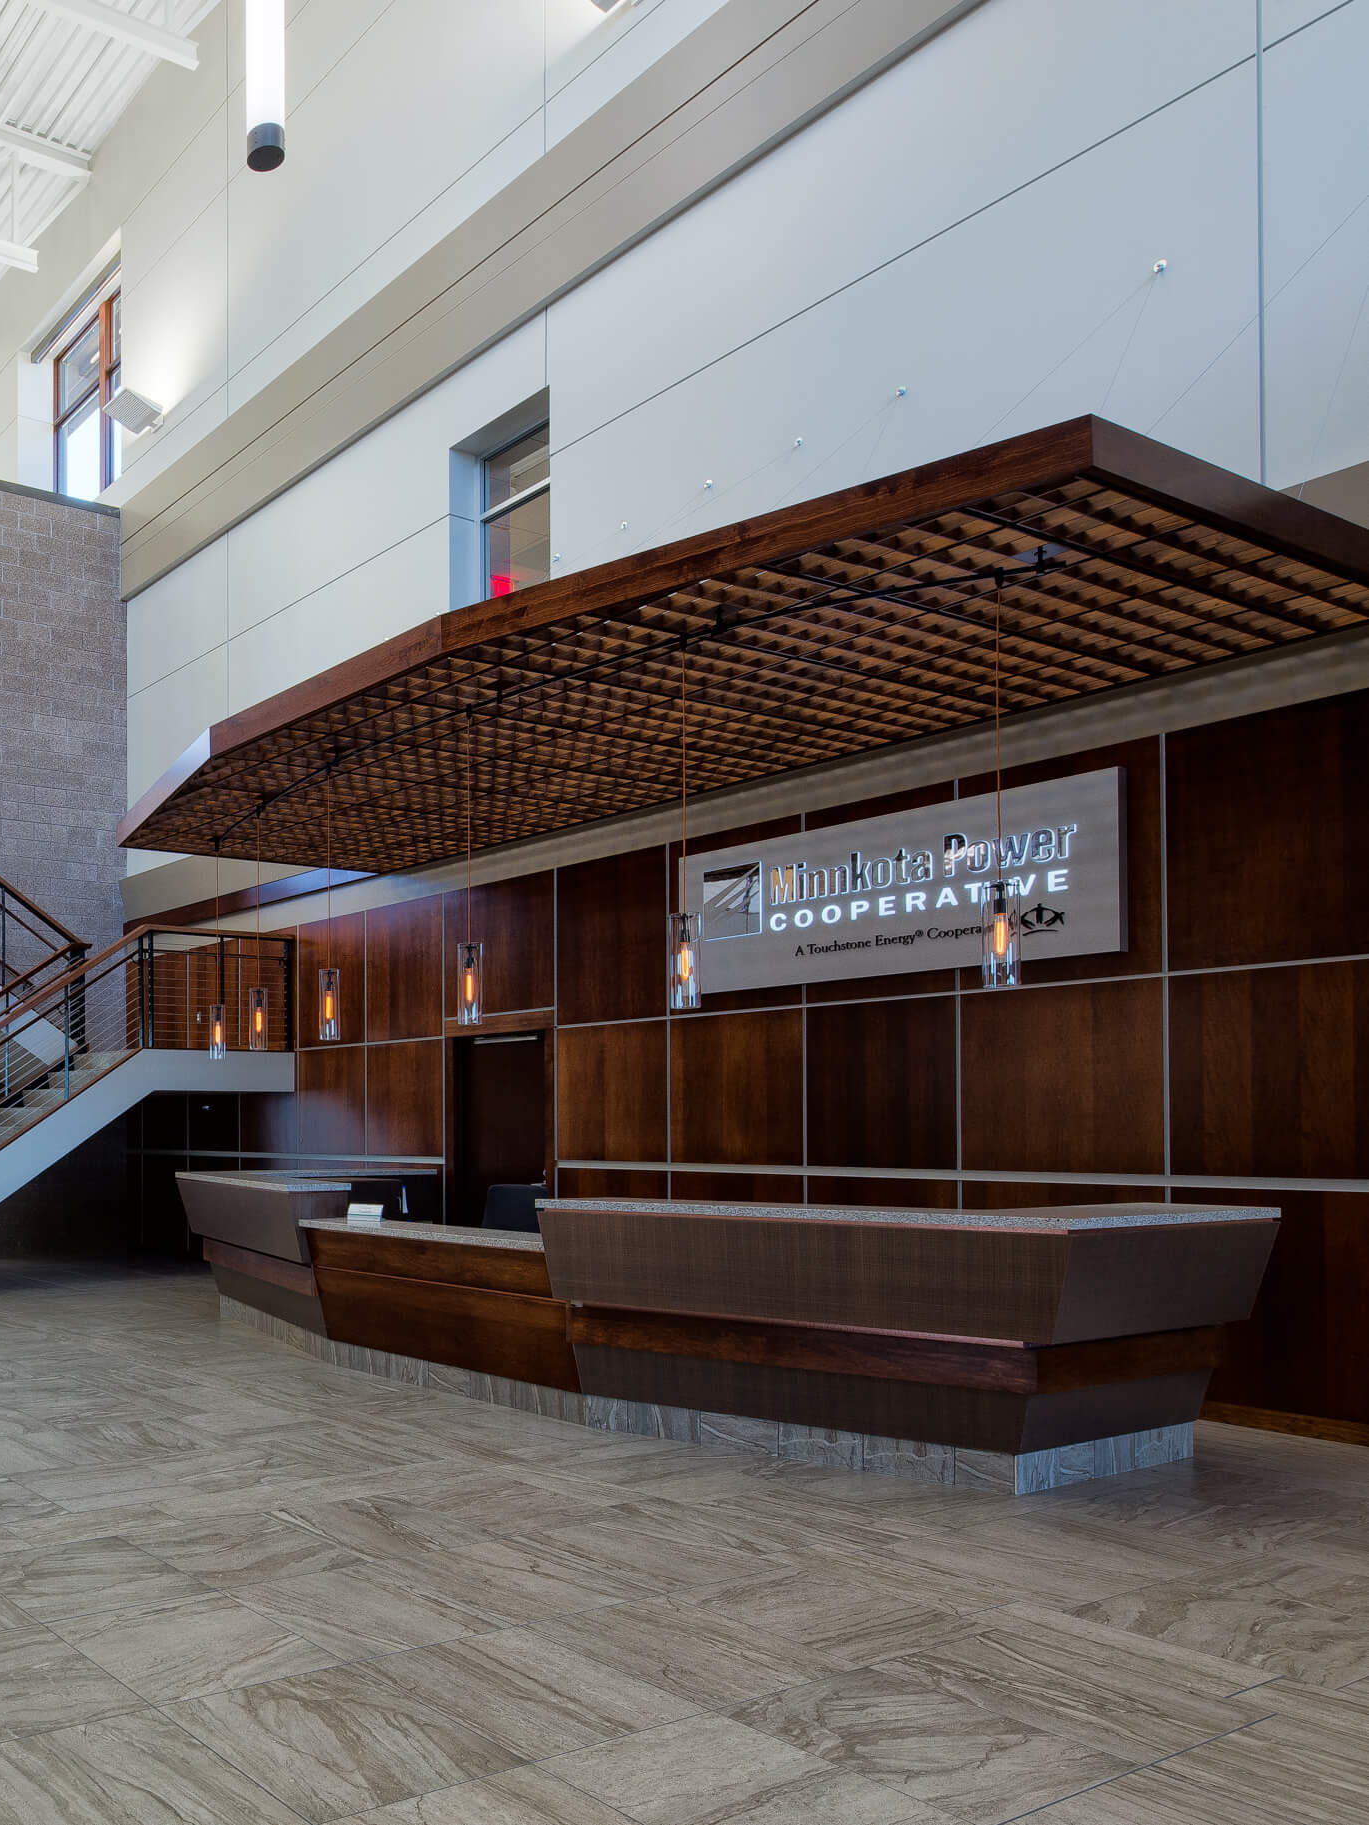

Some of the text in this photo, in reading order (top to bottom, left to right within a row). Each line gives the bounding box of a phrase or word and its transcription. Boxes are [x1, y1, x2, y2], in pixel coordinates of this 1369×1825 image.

[771, 824, 1077, 905] Minnkota Power
[769, 869, 1069, 931] COOPERATVE
[795, 945, 805, 957] A
[807, 939, 872, 955] Touchstone
